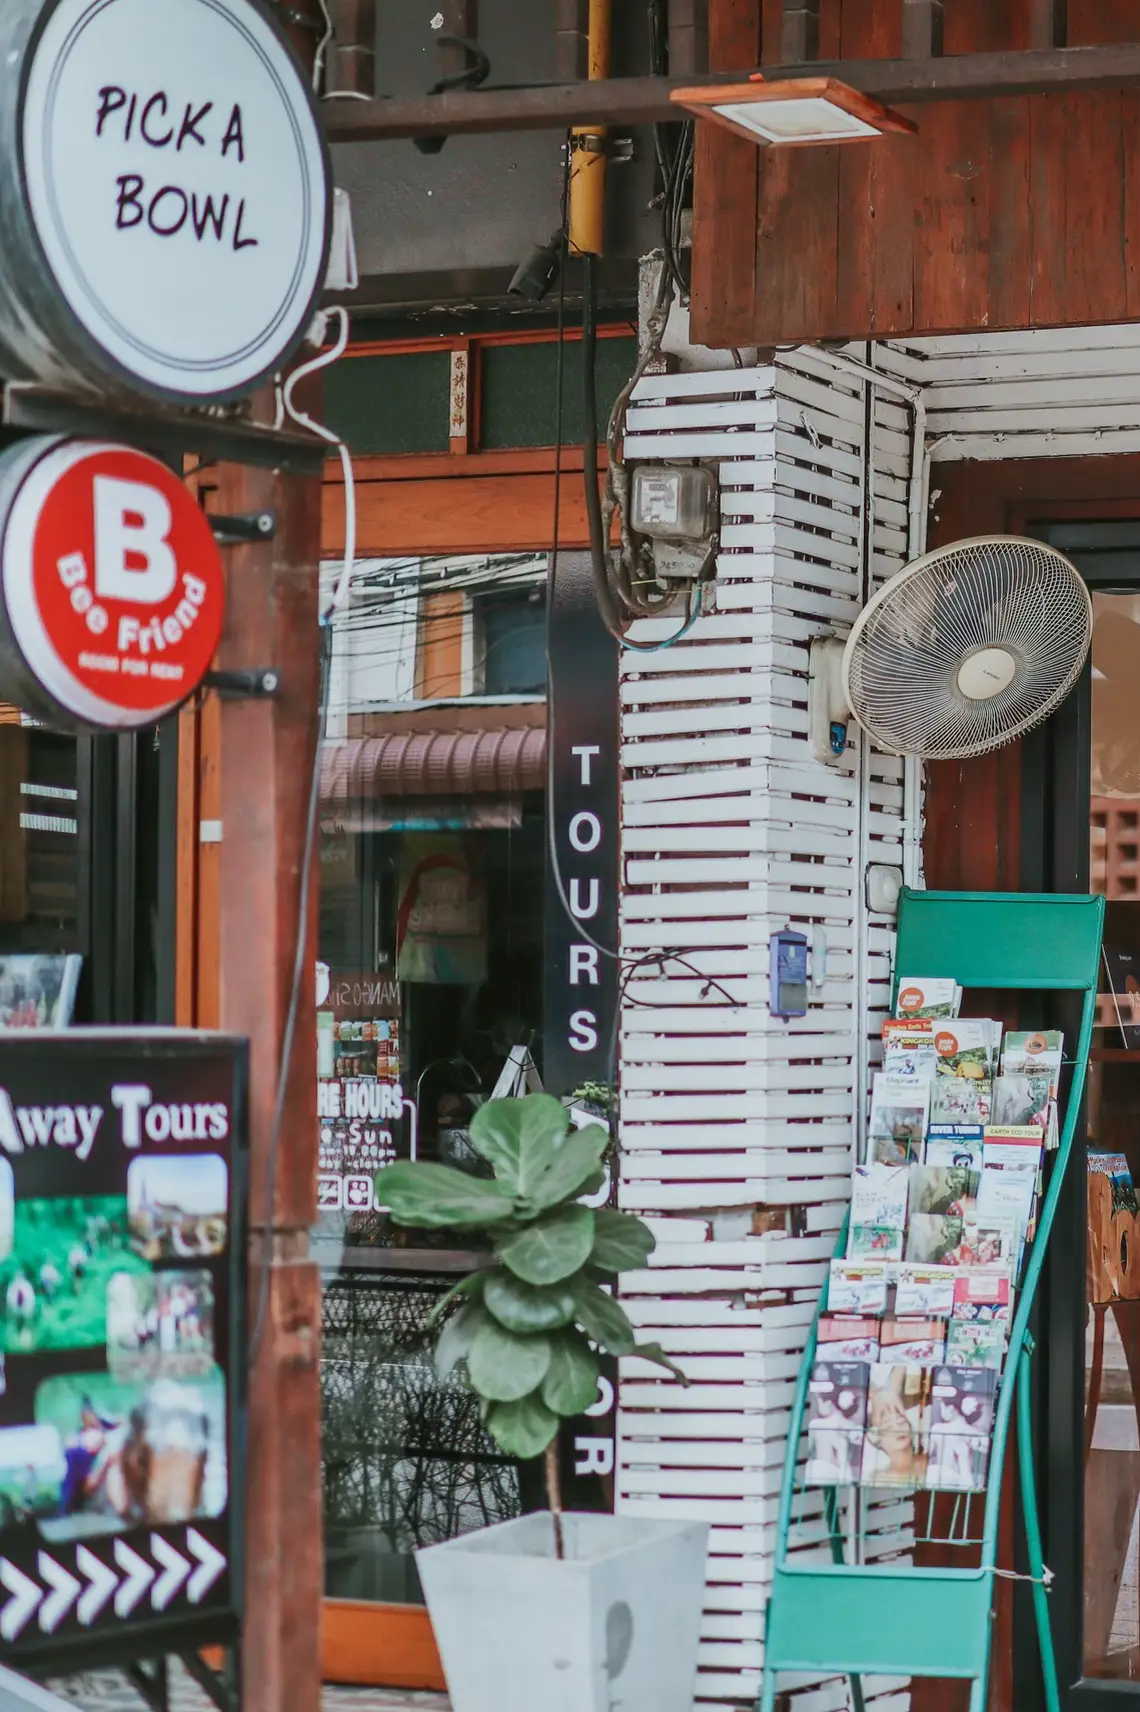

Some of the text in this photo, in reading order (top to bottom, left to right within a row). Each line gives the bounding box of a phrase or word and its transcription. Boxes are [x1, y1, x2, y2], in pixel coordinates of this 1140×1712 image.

[96, 86, 244, 163] PICK A
[115, 174, 258, 251] BOWL
[92, 473, 178, 605] B
[57, 551, 206, 654] Bee Friend
[568, 745, 601, 1052] TOURS
[111, 1084, 228, 1149] Tours
[345, 1083, 403, 1119] HOURS
